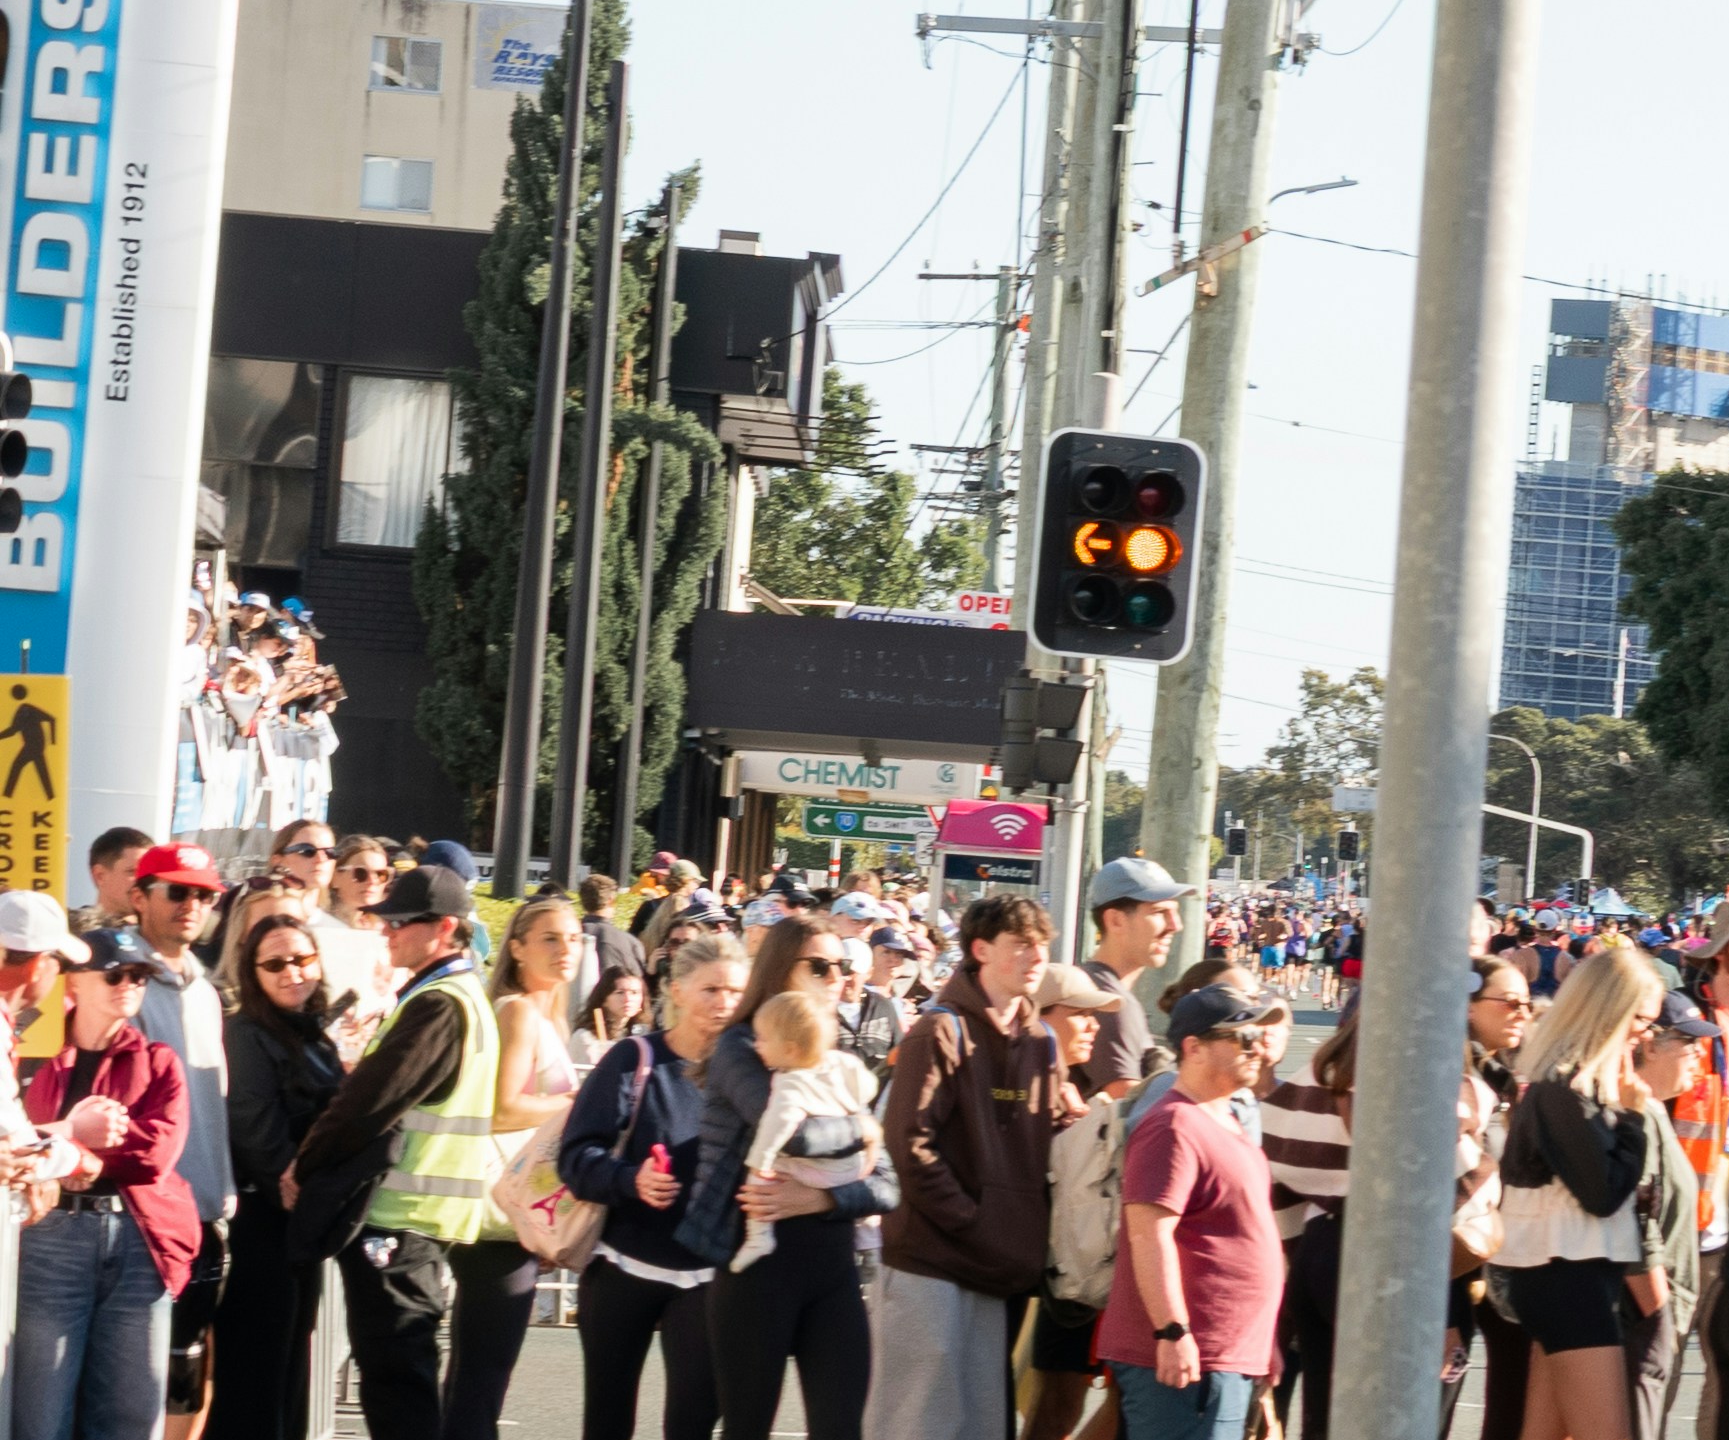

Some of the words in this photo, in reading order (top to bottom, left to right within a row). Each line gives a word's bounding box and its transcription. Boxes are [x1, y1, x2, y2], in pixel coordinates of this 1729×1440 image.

[123, 161, 150, 228] 1912
[105, 237, 142, 403] Established
[777, 757, 903, 790] CHEMIST
[31, 810, 54, 891] KEEP
[976, 863, 1033, 880] Telstra
